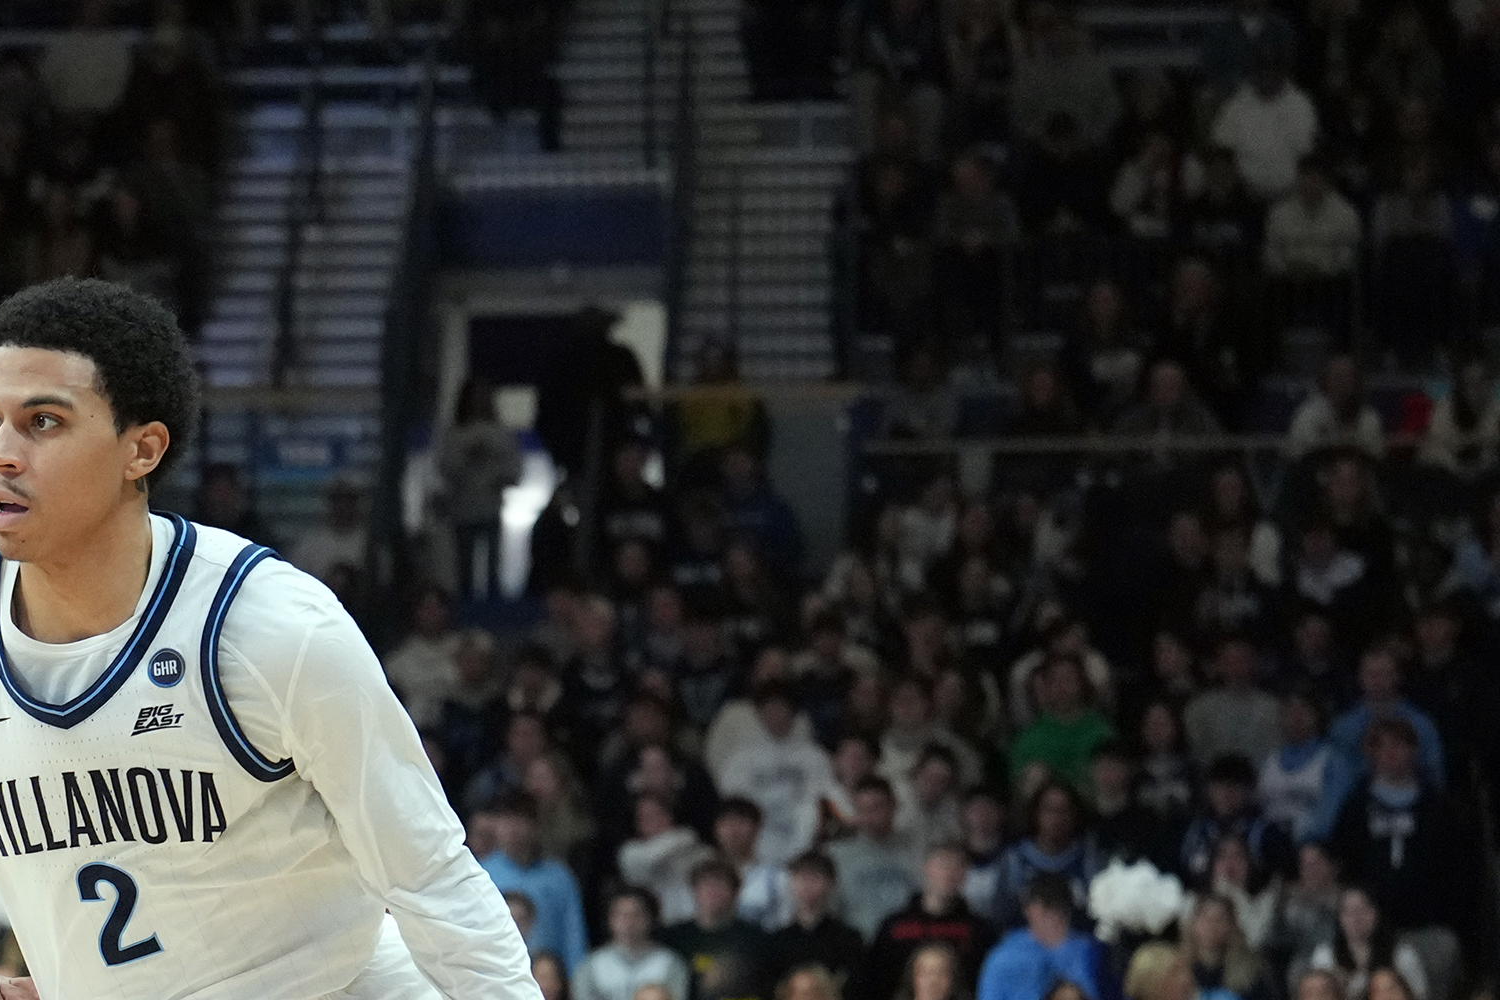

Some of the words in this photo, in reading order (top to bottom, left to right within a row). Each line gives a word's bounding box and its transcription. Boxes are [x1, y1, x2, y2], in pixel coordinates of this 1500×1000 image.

[153, 659, 178, 677] GHR
[138, 703, 174, 719] BIG
[133, 713, 185, 730] EAST
[75, 861, 164, 967] 2
